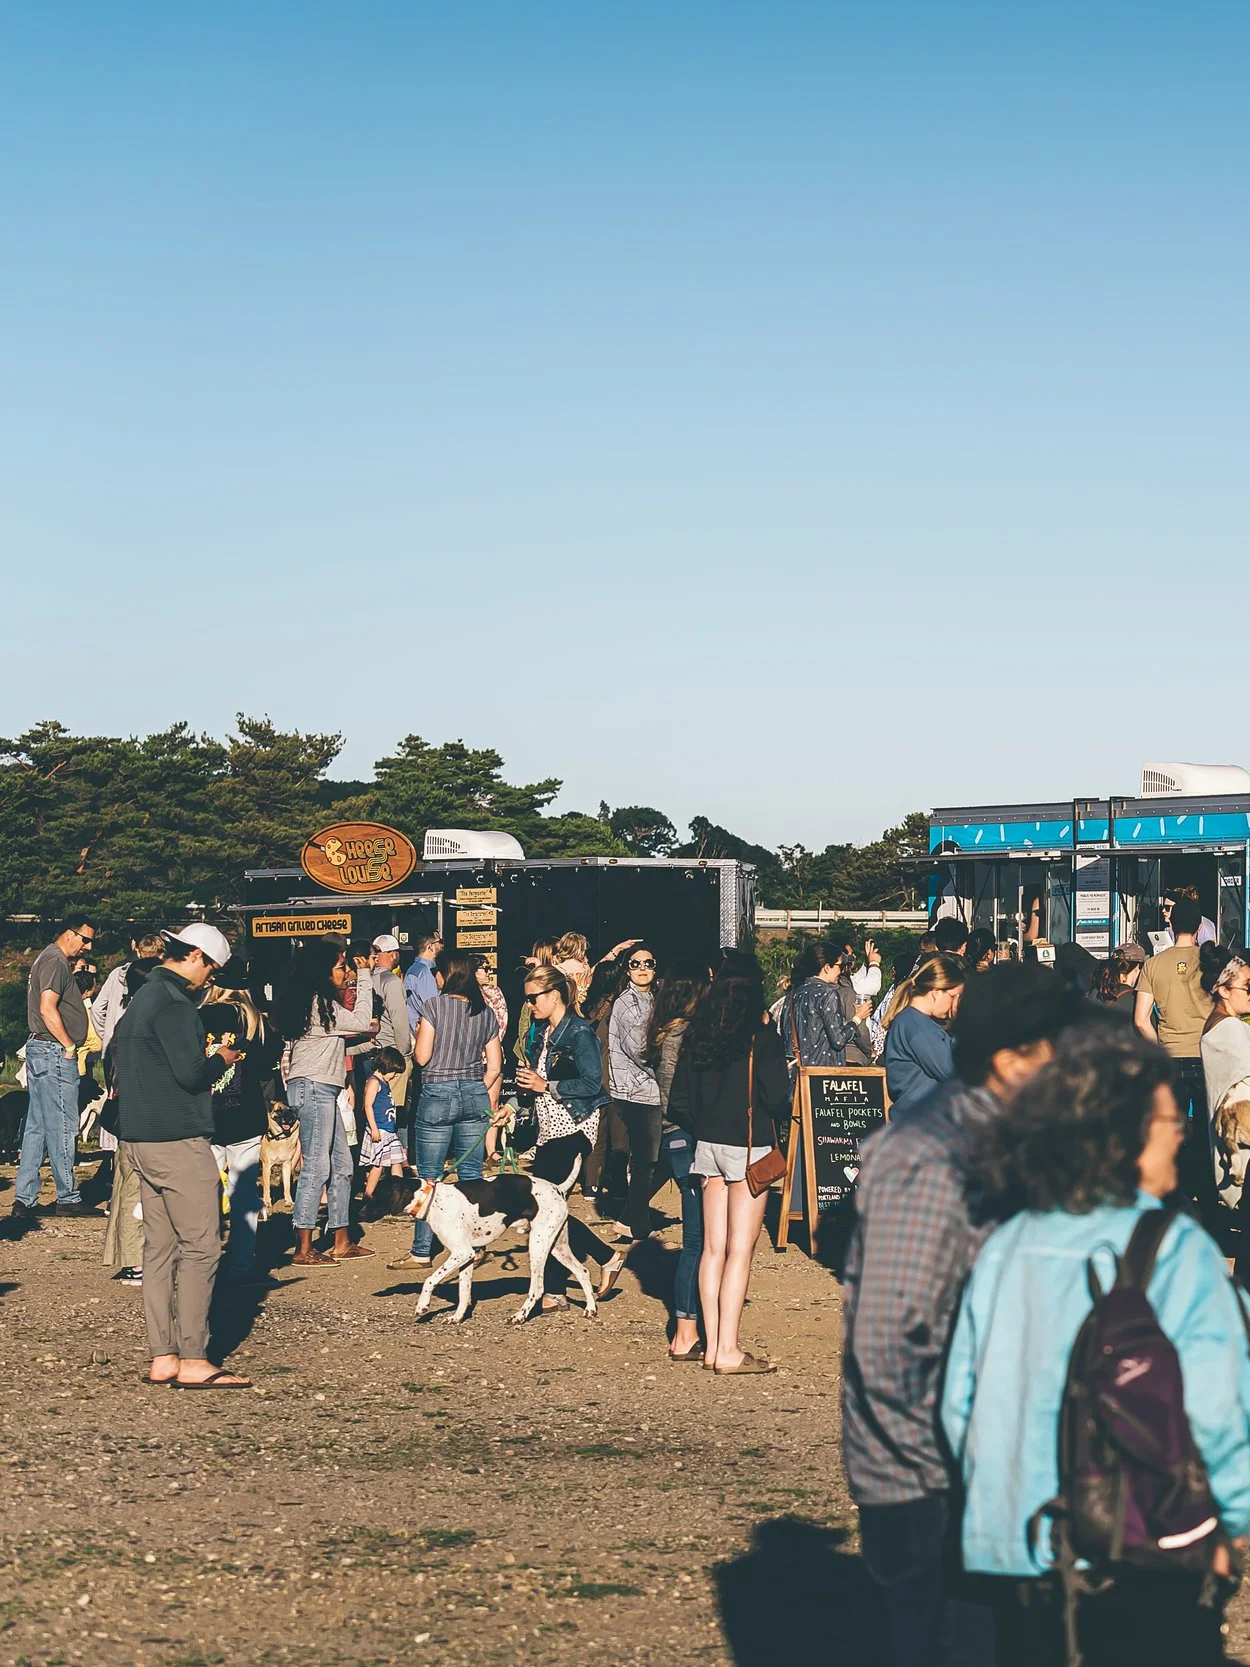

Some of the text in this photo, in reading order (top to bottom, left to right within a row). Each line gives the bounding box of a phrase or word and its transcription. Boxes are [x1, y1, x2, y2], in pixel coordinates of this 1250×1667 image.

[255, 919, 348, 933] ARTISAN GRILLED CHEESE
[822, 1079, 868, 1095] FALAFEL
[814, 1107, 883, 1120] FALAFEL POCKETS
[843, 1119, 867, 1131] BOWLS
[818, 1185, 842, 1194] POWERED
